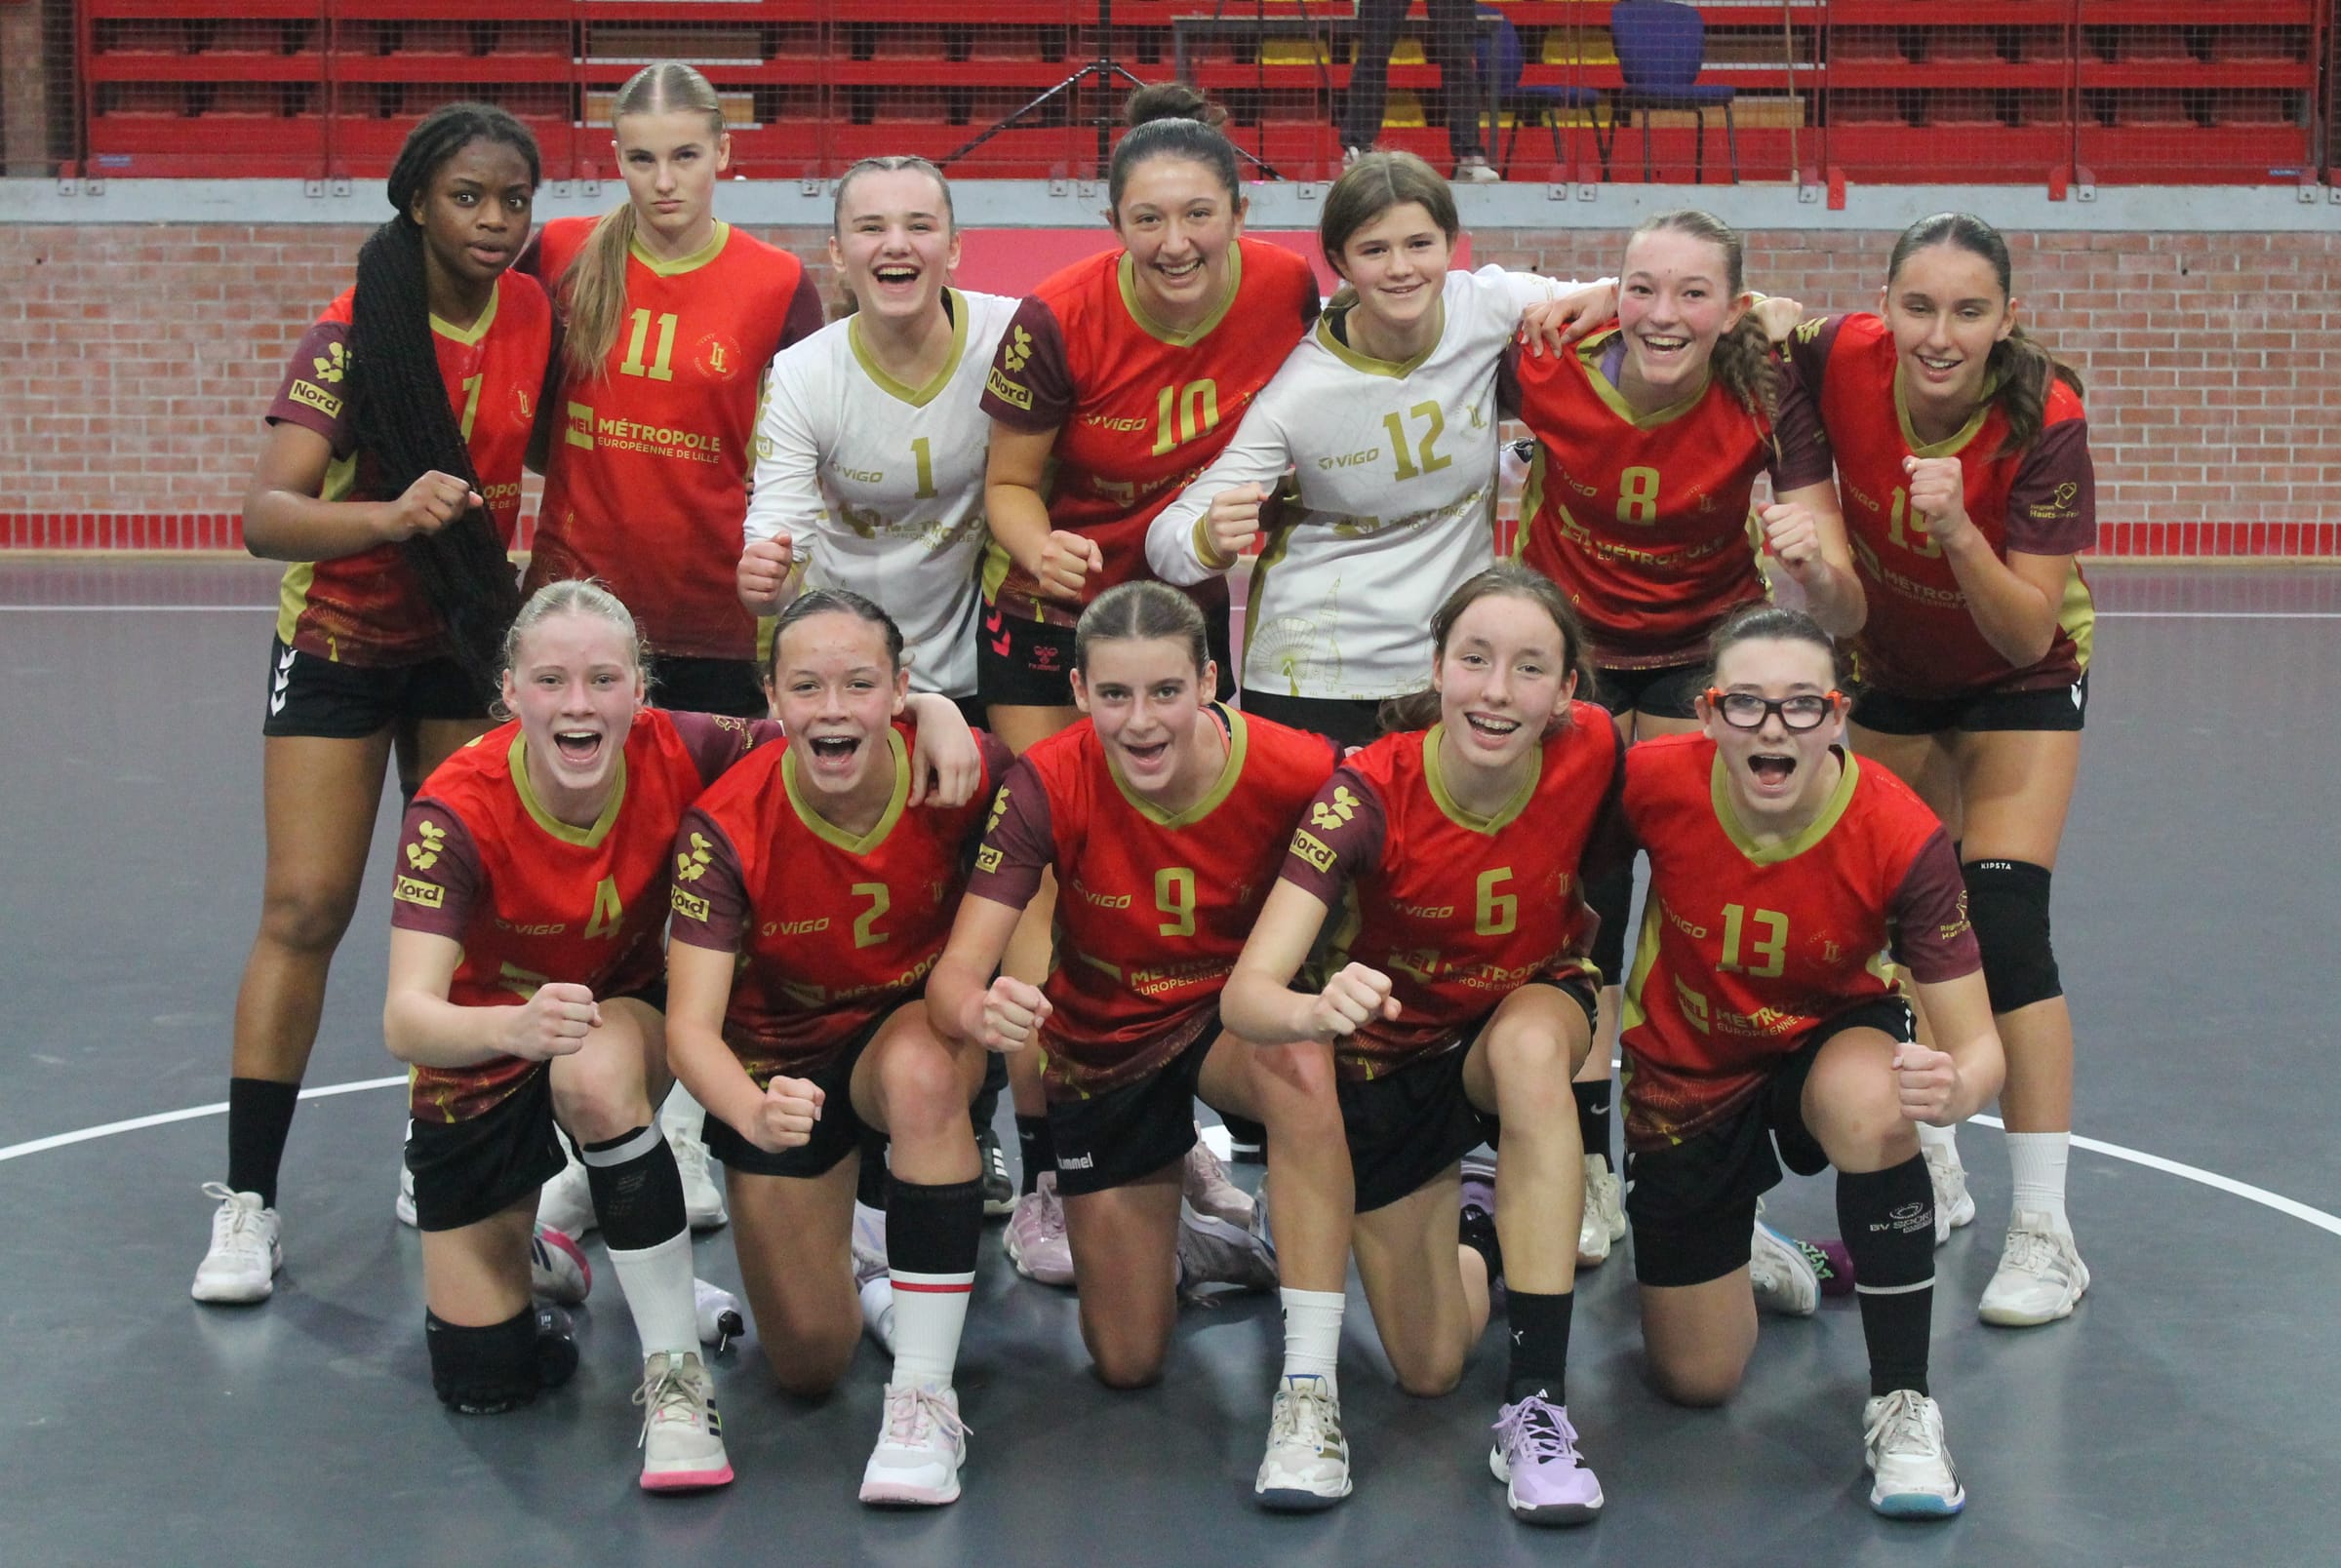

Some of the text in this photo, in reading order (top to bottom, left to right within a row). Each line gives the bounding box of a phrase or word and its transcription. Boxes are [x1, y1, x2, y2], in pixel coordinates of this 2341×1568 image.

[619, 307, 678, 382] 11
[293, 381, 338, 413] Nord
[989, 372, 1030, 404] Nord
[1151, 378, 1219, 456] 10
[598, 417, 720, 452] MÉTROPOLE
[676, 449, 690, 459] DE
[693, 451, 719, 464] LILLE
[910, 437, 938, 499] 1
[1382, 400, 1452, 482] 12
[1616, 465, 1660, 527] 8
[584, 873, 623, 940] 4
[851, 882, 891, 950] 2
[1155, 867, 1196, 937] 9
[1475, 866, 1518, 936] 6
[1716, 903, 1789, 978] 13
